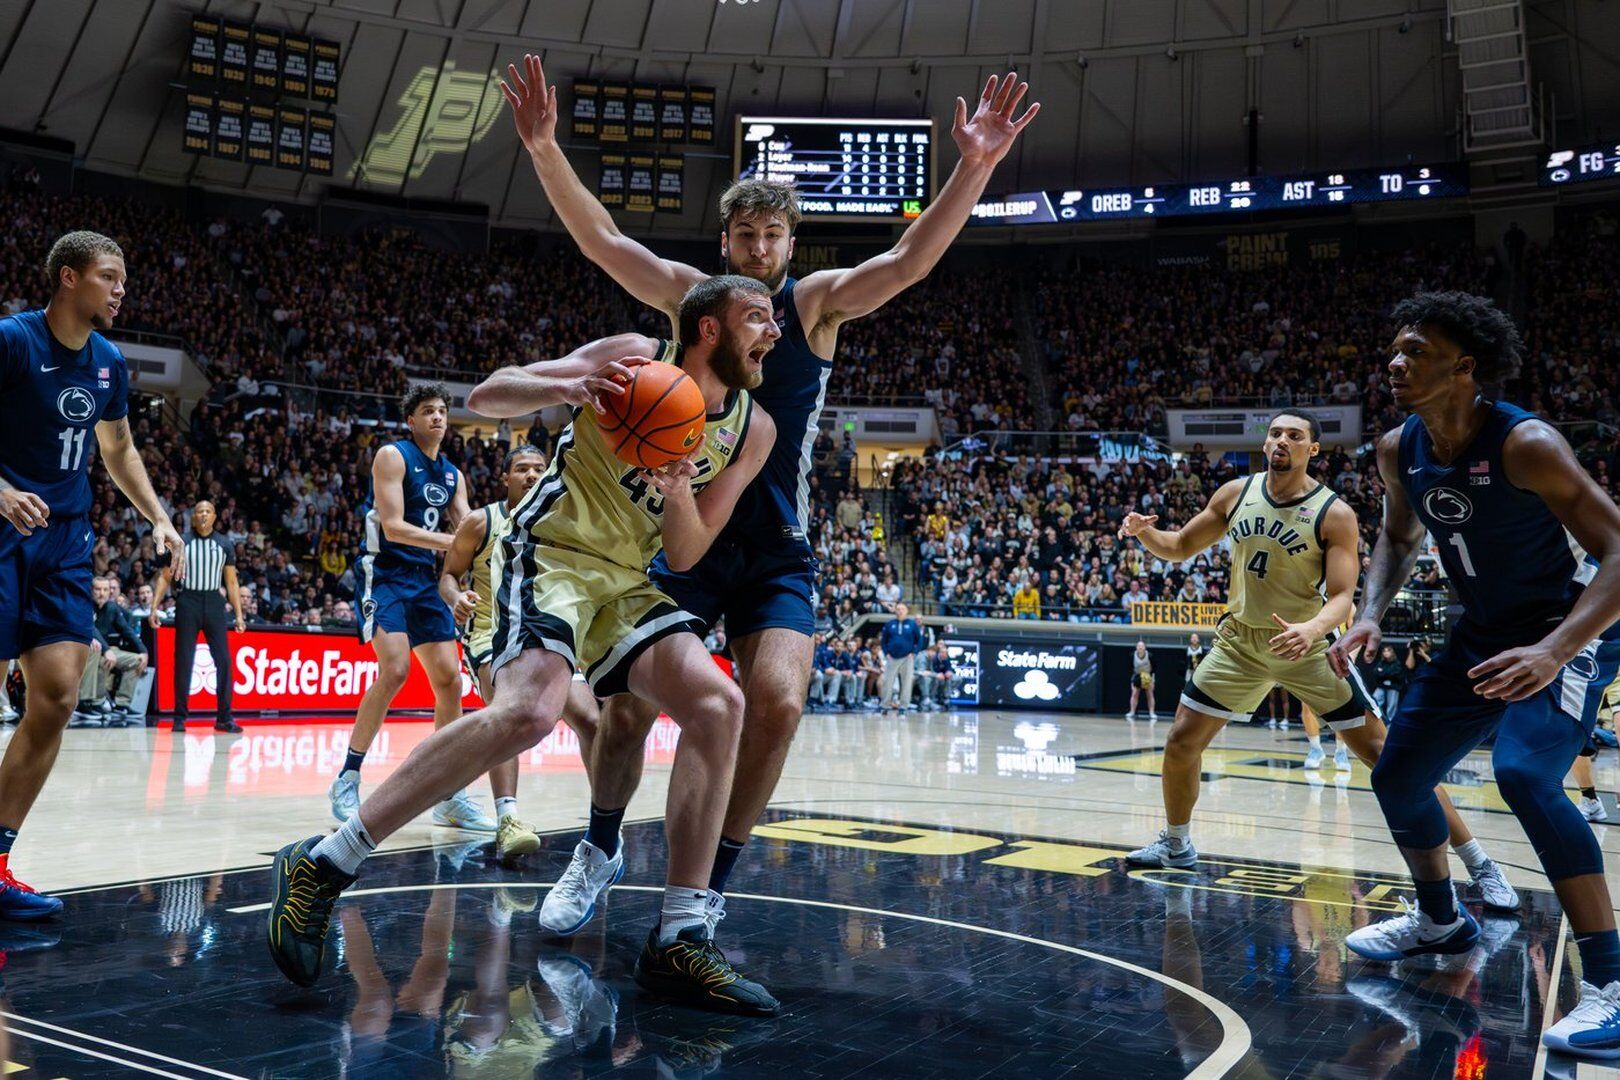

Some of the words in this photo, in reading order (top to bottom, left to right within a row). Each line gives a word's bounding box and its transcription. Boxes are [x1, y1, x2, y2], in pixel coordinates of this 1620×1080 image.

[1580, 152, 1604, 173] FG
[1282, 181, 1315, 201] AST
[1380, 174, 1402, 193] TO
[1419, 168, 1430, 179] 3
[1092, 193, 1132, 213] OREB
[1189, 187, 1221, 206] REB
[1230, 181, 1250, 192] 22
[836, 202, 865, 212] MADE
[1144, 203, 1154, 214] 4
[1226, 232, 1289, 253] PAINT
[1226, 252, 1289, 271] CREW
[58, 427, 87, 471] 11
[423, 506, 439, 532] 9
[1230, 516, 1309, 557] PURDUE
[1247, 550, 1269, 579] 4
[1448, 532, 1477, 577] 1
[1134, 603, 1199, 626] DEFENSE
[1201, 615, 1219, 626] HER
